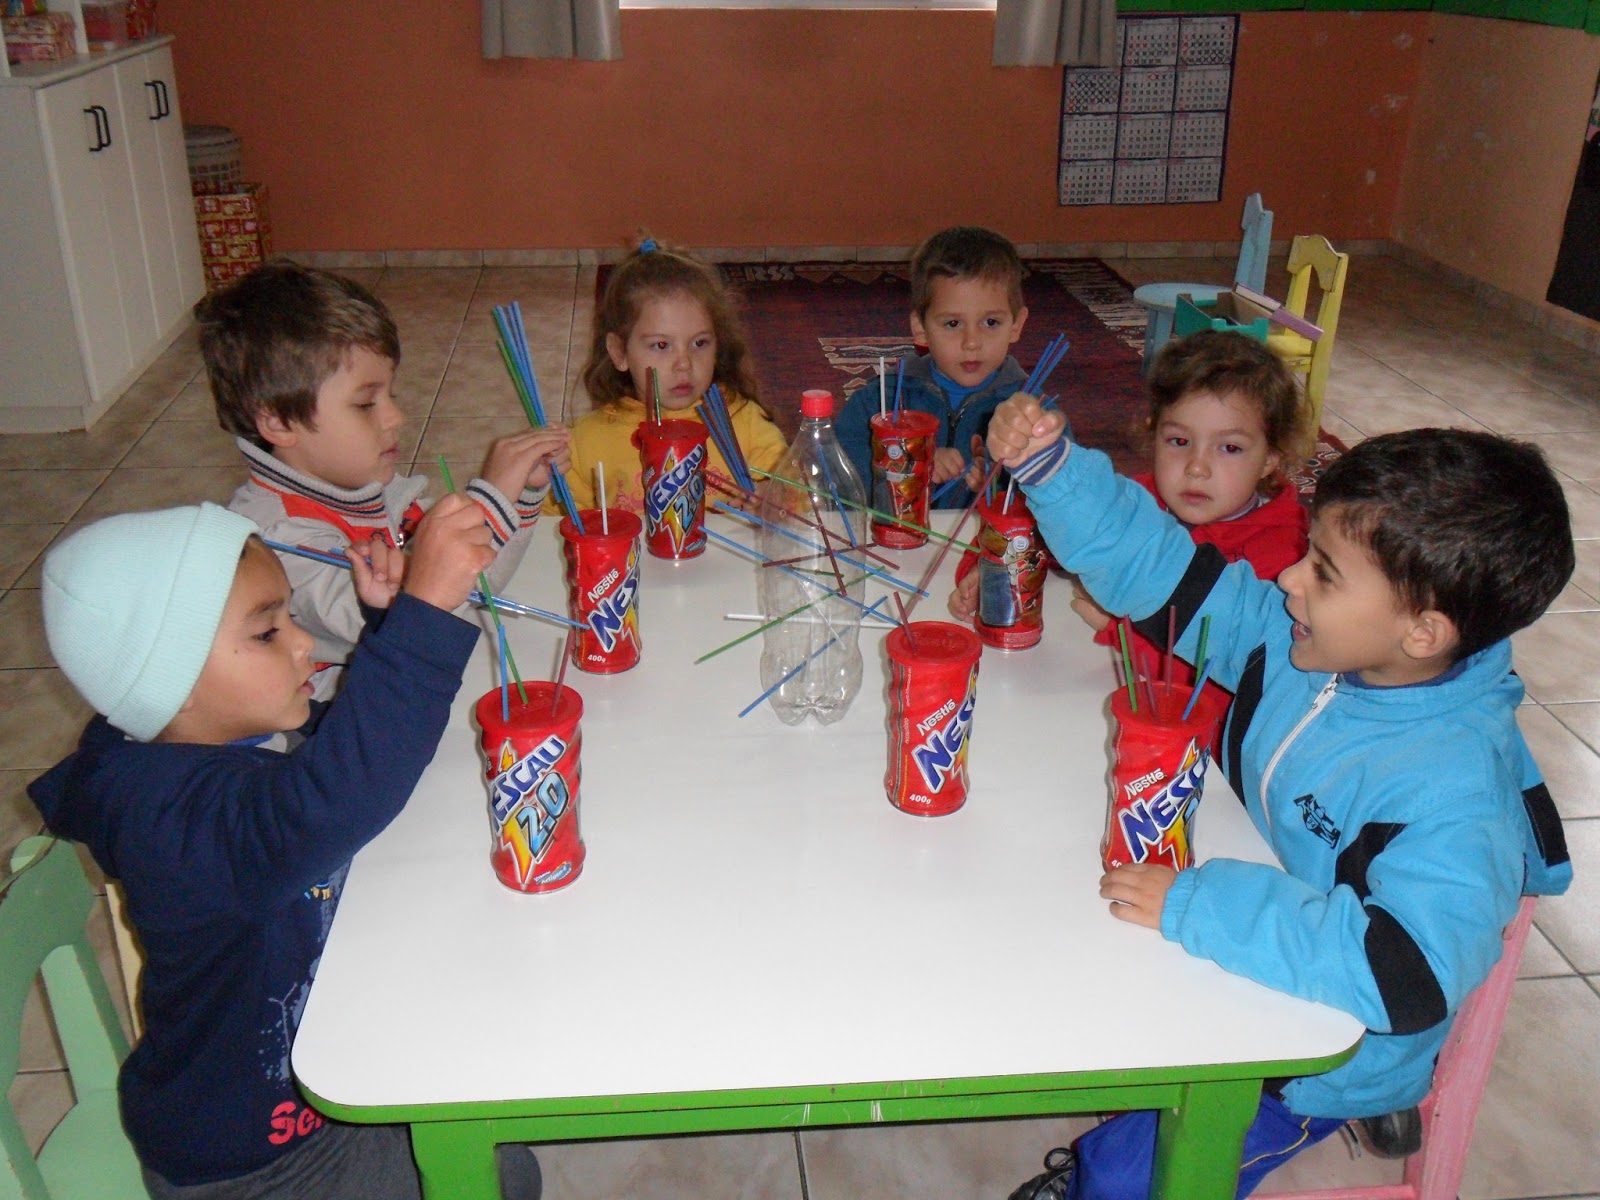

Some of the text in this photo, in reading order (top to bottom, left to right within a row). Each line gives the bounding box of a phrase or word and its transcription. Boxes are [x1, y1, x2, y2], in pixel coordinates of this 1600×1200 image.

[916, 698, 956, 736] Nestlé
[909, 793, 932, 805] 400g
[1123, 767, 1165, 800] Nestlé
[516, 771, 569, 859] 2.0
